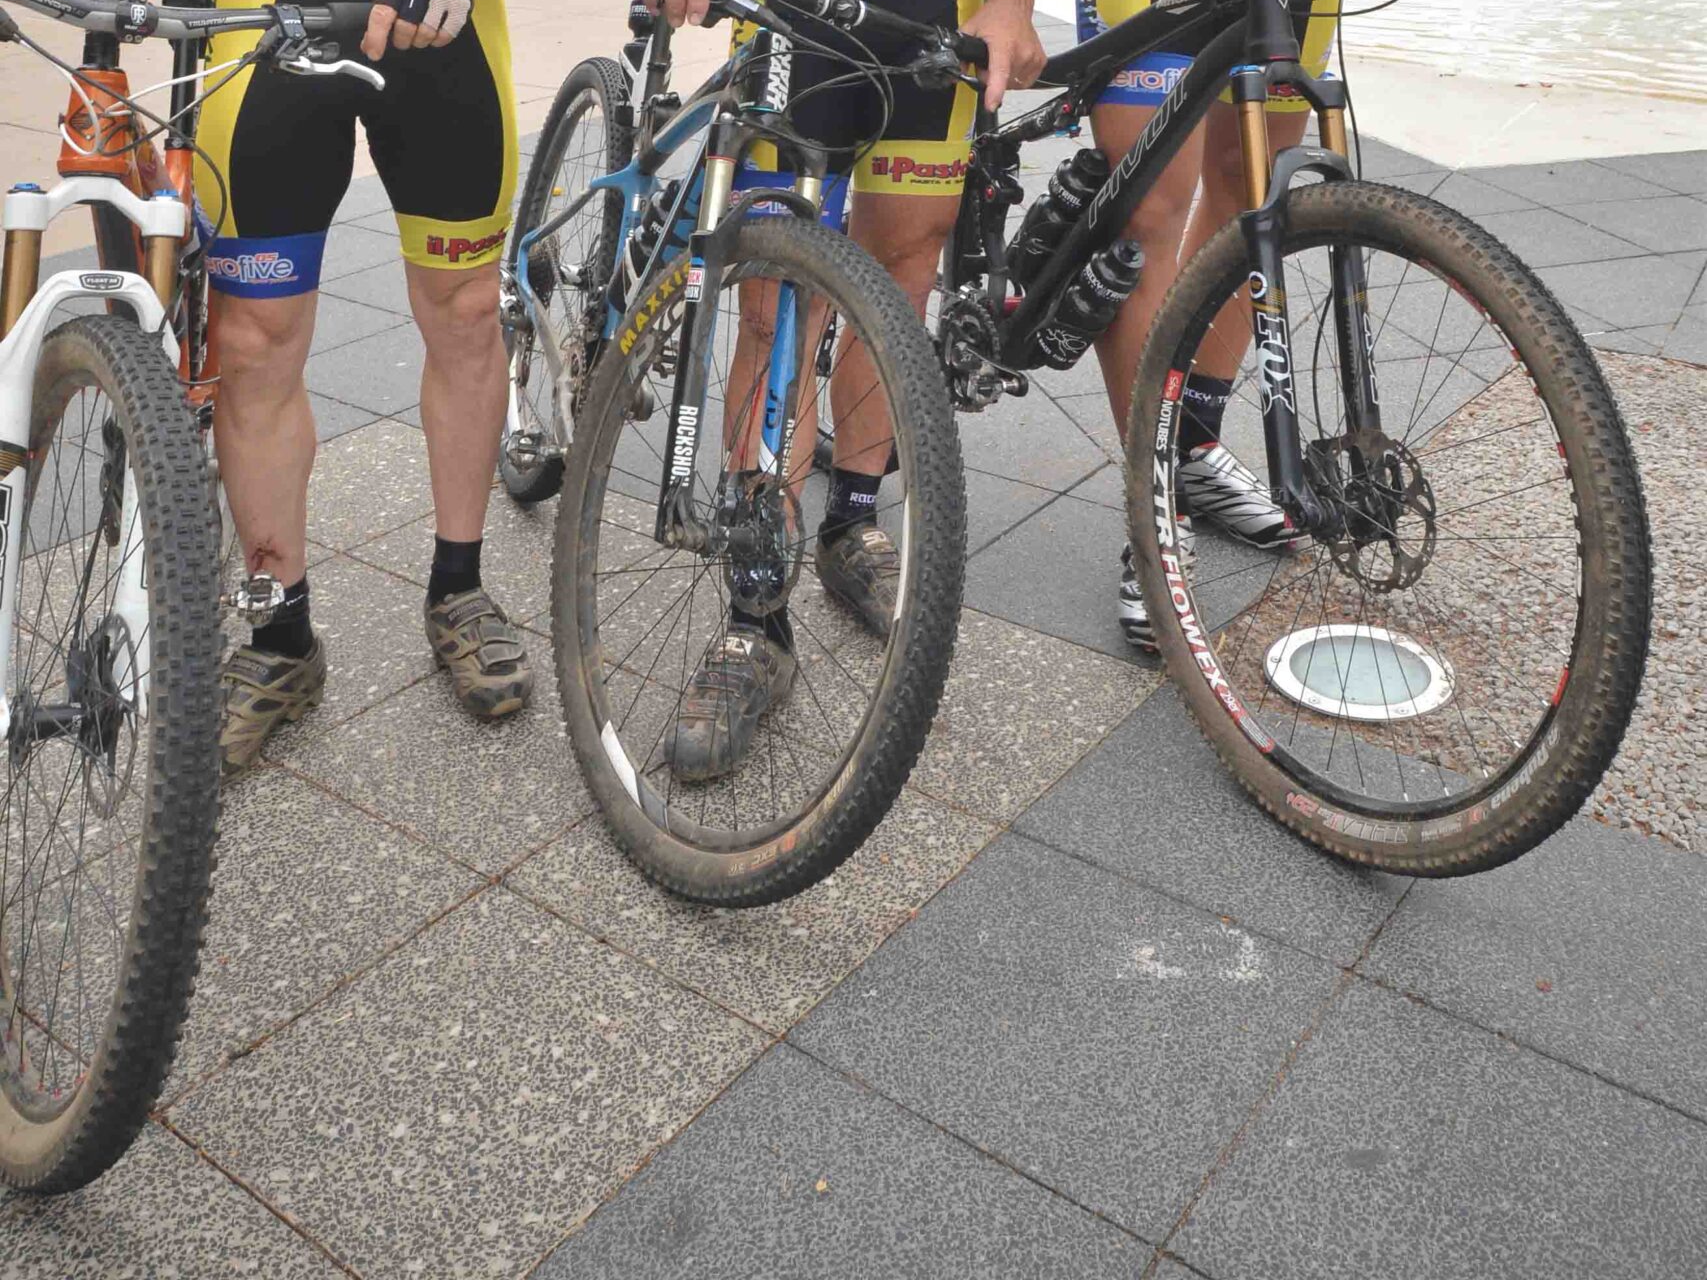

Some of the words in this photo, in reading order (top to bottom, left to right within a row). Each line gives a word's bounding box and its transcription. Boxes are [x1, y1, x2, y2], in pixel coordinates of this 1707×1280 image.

[205, 254, 294, 283] erofive
[1256, 312, 1296, 417] FOX
[1156, 400, 1174, 453] NOTUBES
[1153, 455, 1173, 549] ZTR
